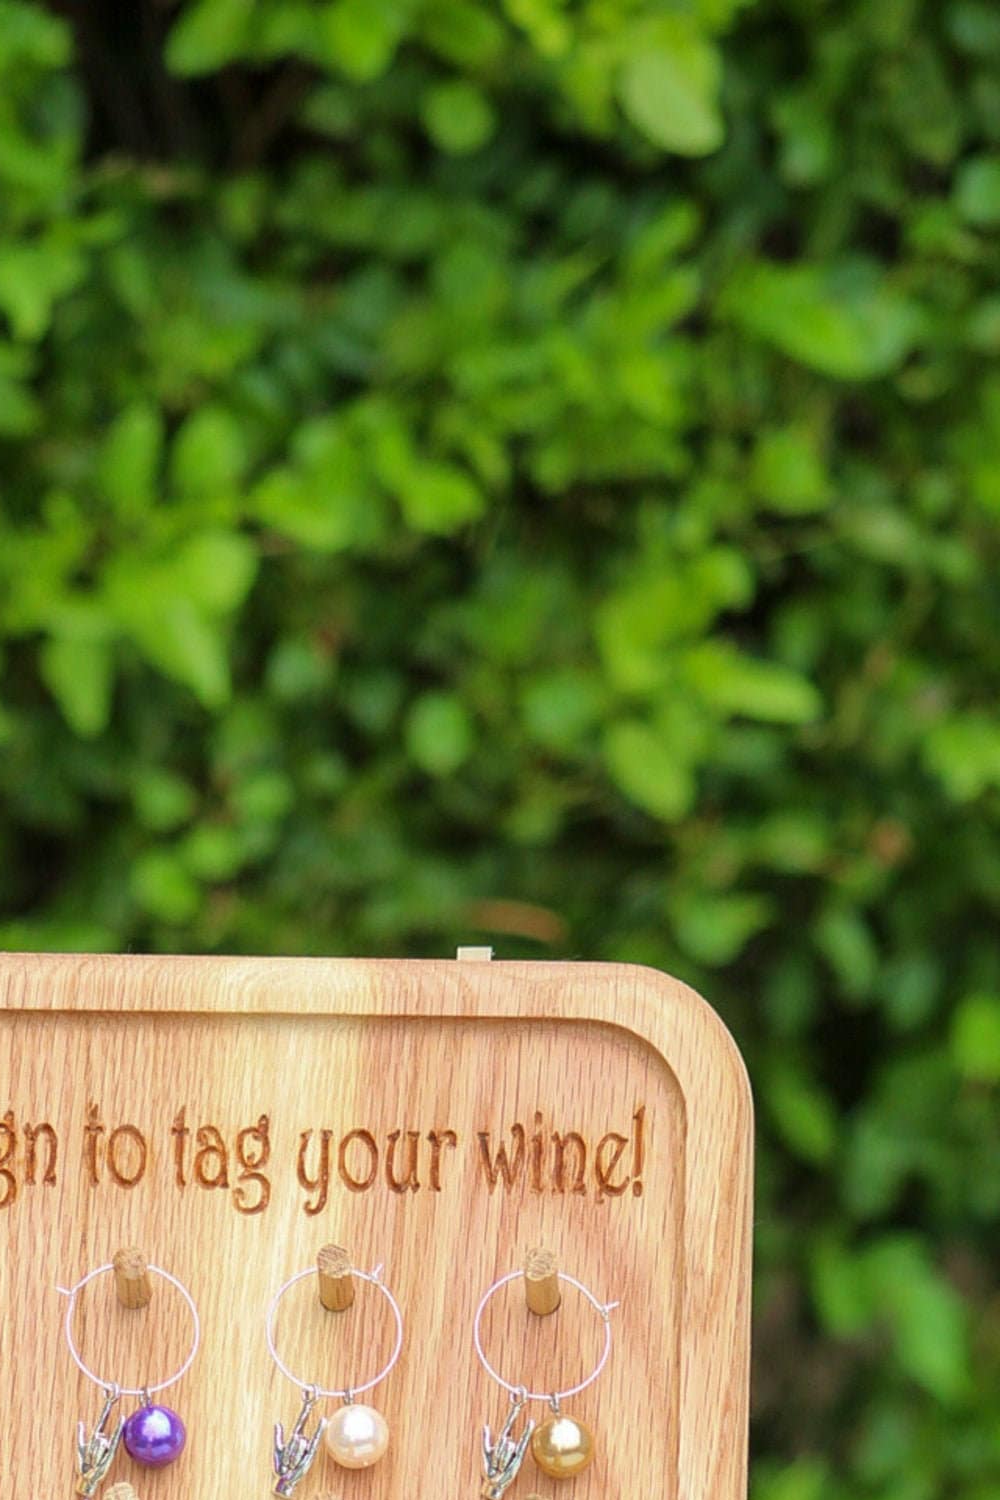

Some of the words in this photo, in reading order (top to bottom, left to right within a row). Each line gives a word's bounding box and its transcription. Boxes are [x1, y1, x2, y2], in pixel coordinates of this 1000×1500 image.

[83, 1100, 148, 1190] to
[170, 1104, 272, 1215] tag
[296, 1127, 458, 1217] your
[476, 1104, 646, 1204] wine!
